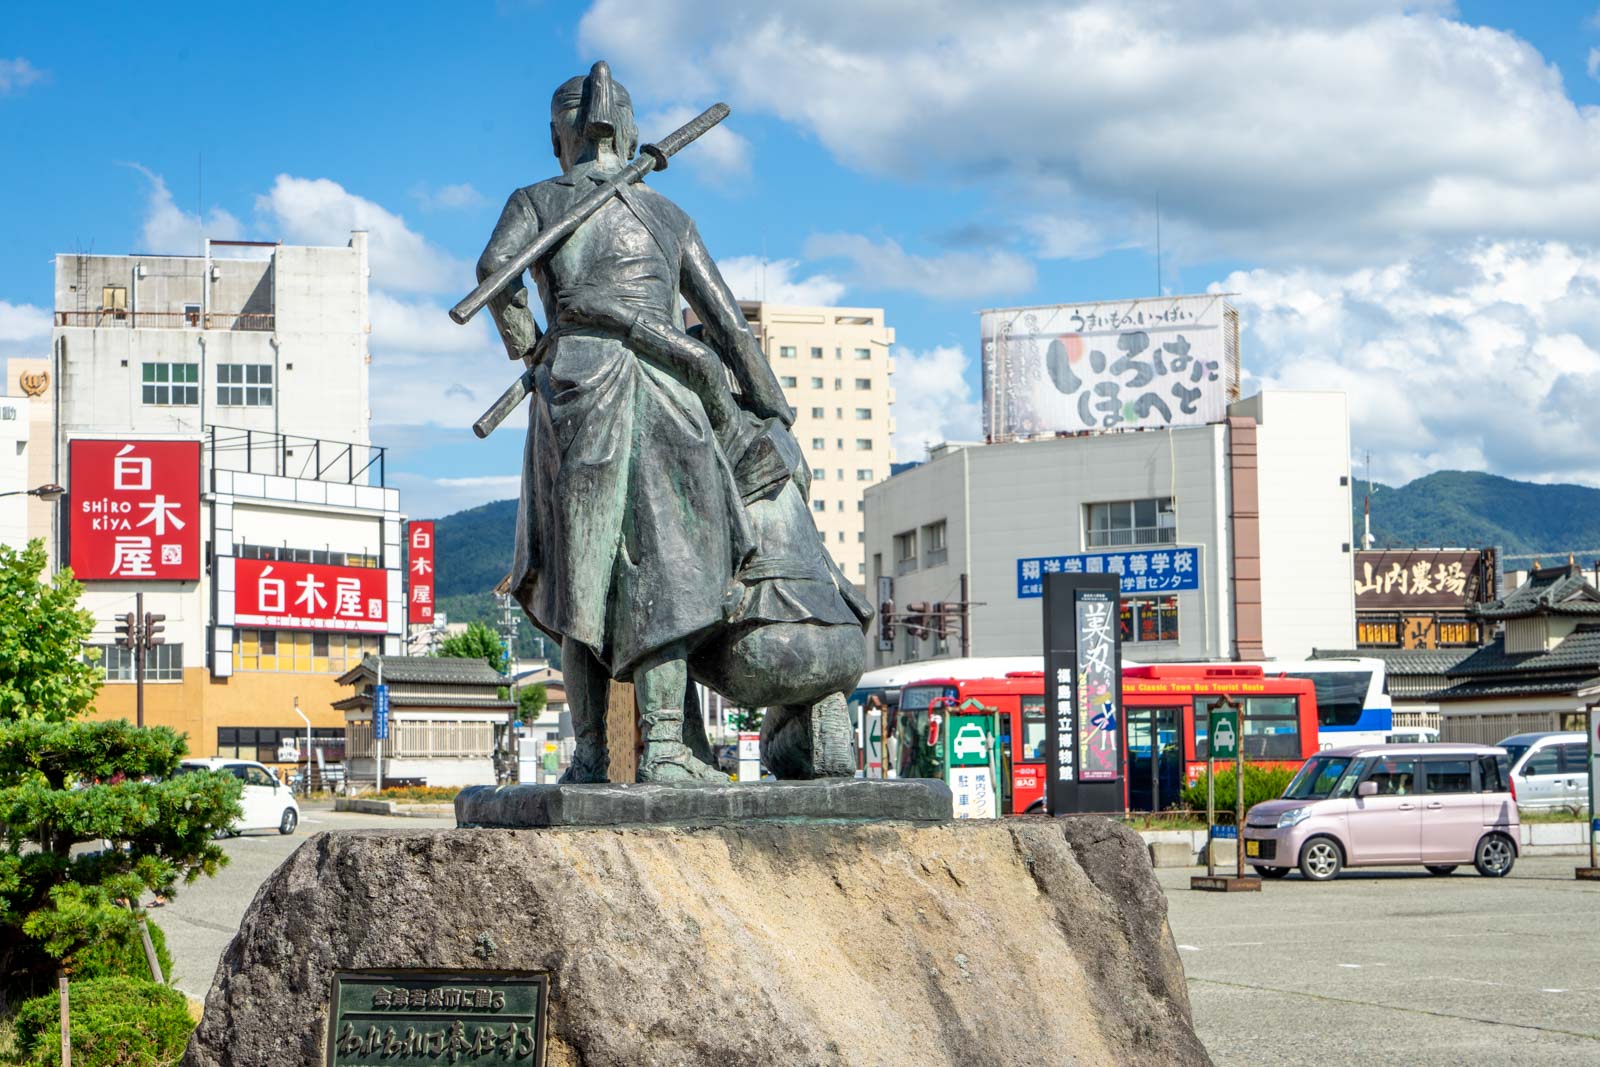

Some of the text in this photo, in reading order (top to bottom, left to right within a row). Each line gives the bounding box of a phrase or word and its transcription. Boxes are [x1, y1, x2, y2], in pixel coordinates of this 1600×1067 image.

[109, 443, 186, 576] 白木屋
[411, 527, 432, 604] 白木屋
[1022, 551, 1193, 581] 翔洋学園高等学校
[1355, 560, 1466, 596] 山内農場
[257, 565, 365, 617] 白木屋
[1139, 682, 1167, 691] Classic
[1171, 683, 1191, 691] Town
[1194, 683, 1209, 691] Bus
[1212, 682, 1239, 691] Tourist
[1242, 683, 1265, 691] Route
[1056, 668, 1073, 781] 福島県立博物館
[372, 986, 506, 1009] 会津若松市に贈る
